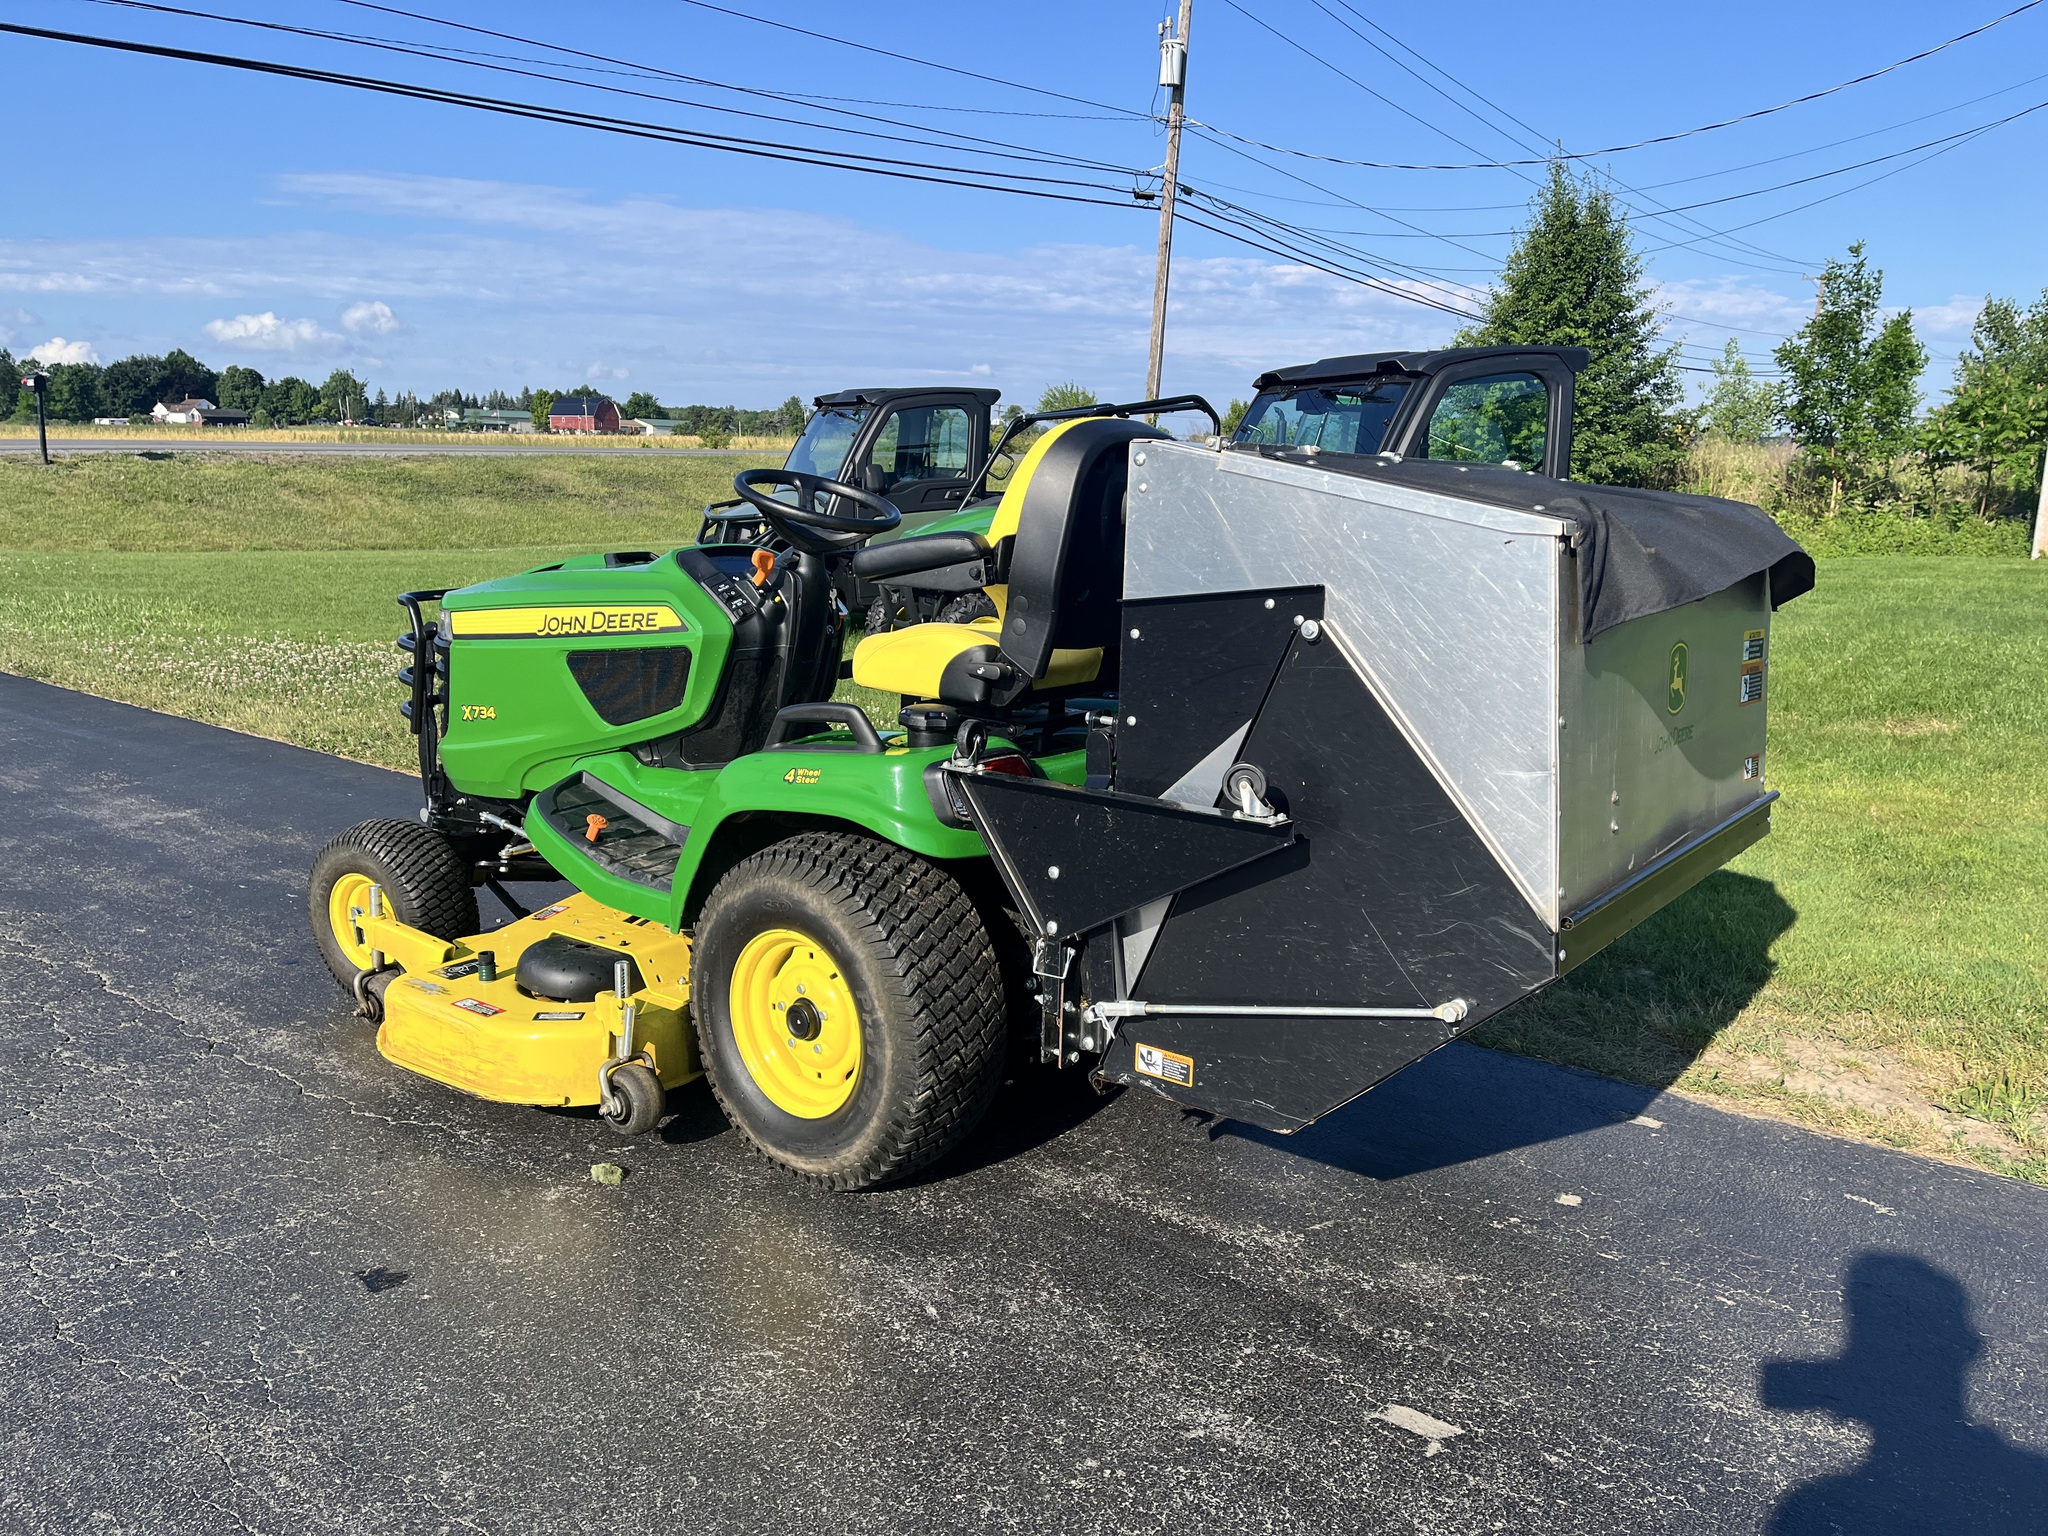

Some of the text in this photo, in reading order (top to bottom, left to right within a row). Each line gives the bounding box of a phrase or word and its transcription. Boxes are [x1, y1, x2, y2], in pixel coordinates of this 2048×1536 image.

[537, 611, 659, 633] JOHN DEERE
[461, 704, 497, 721] X734
[783, 768, 822, 783] 4 Wheel
[795, 775, 819, 784] Steer
